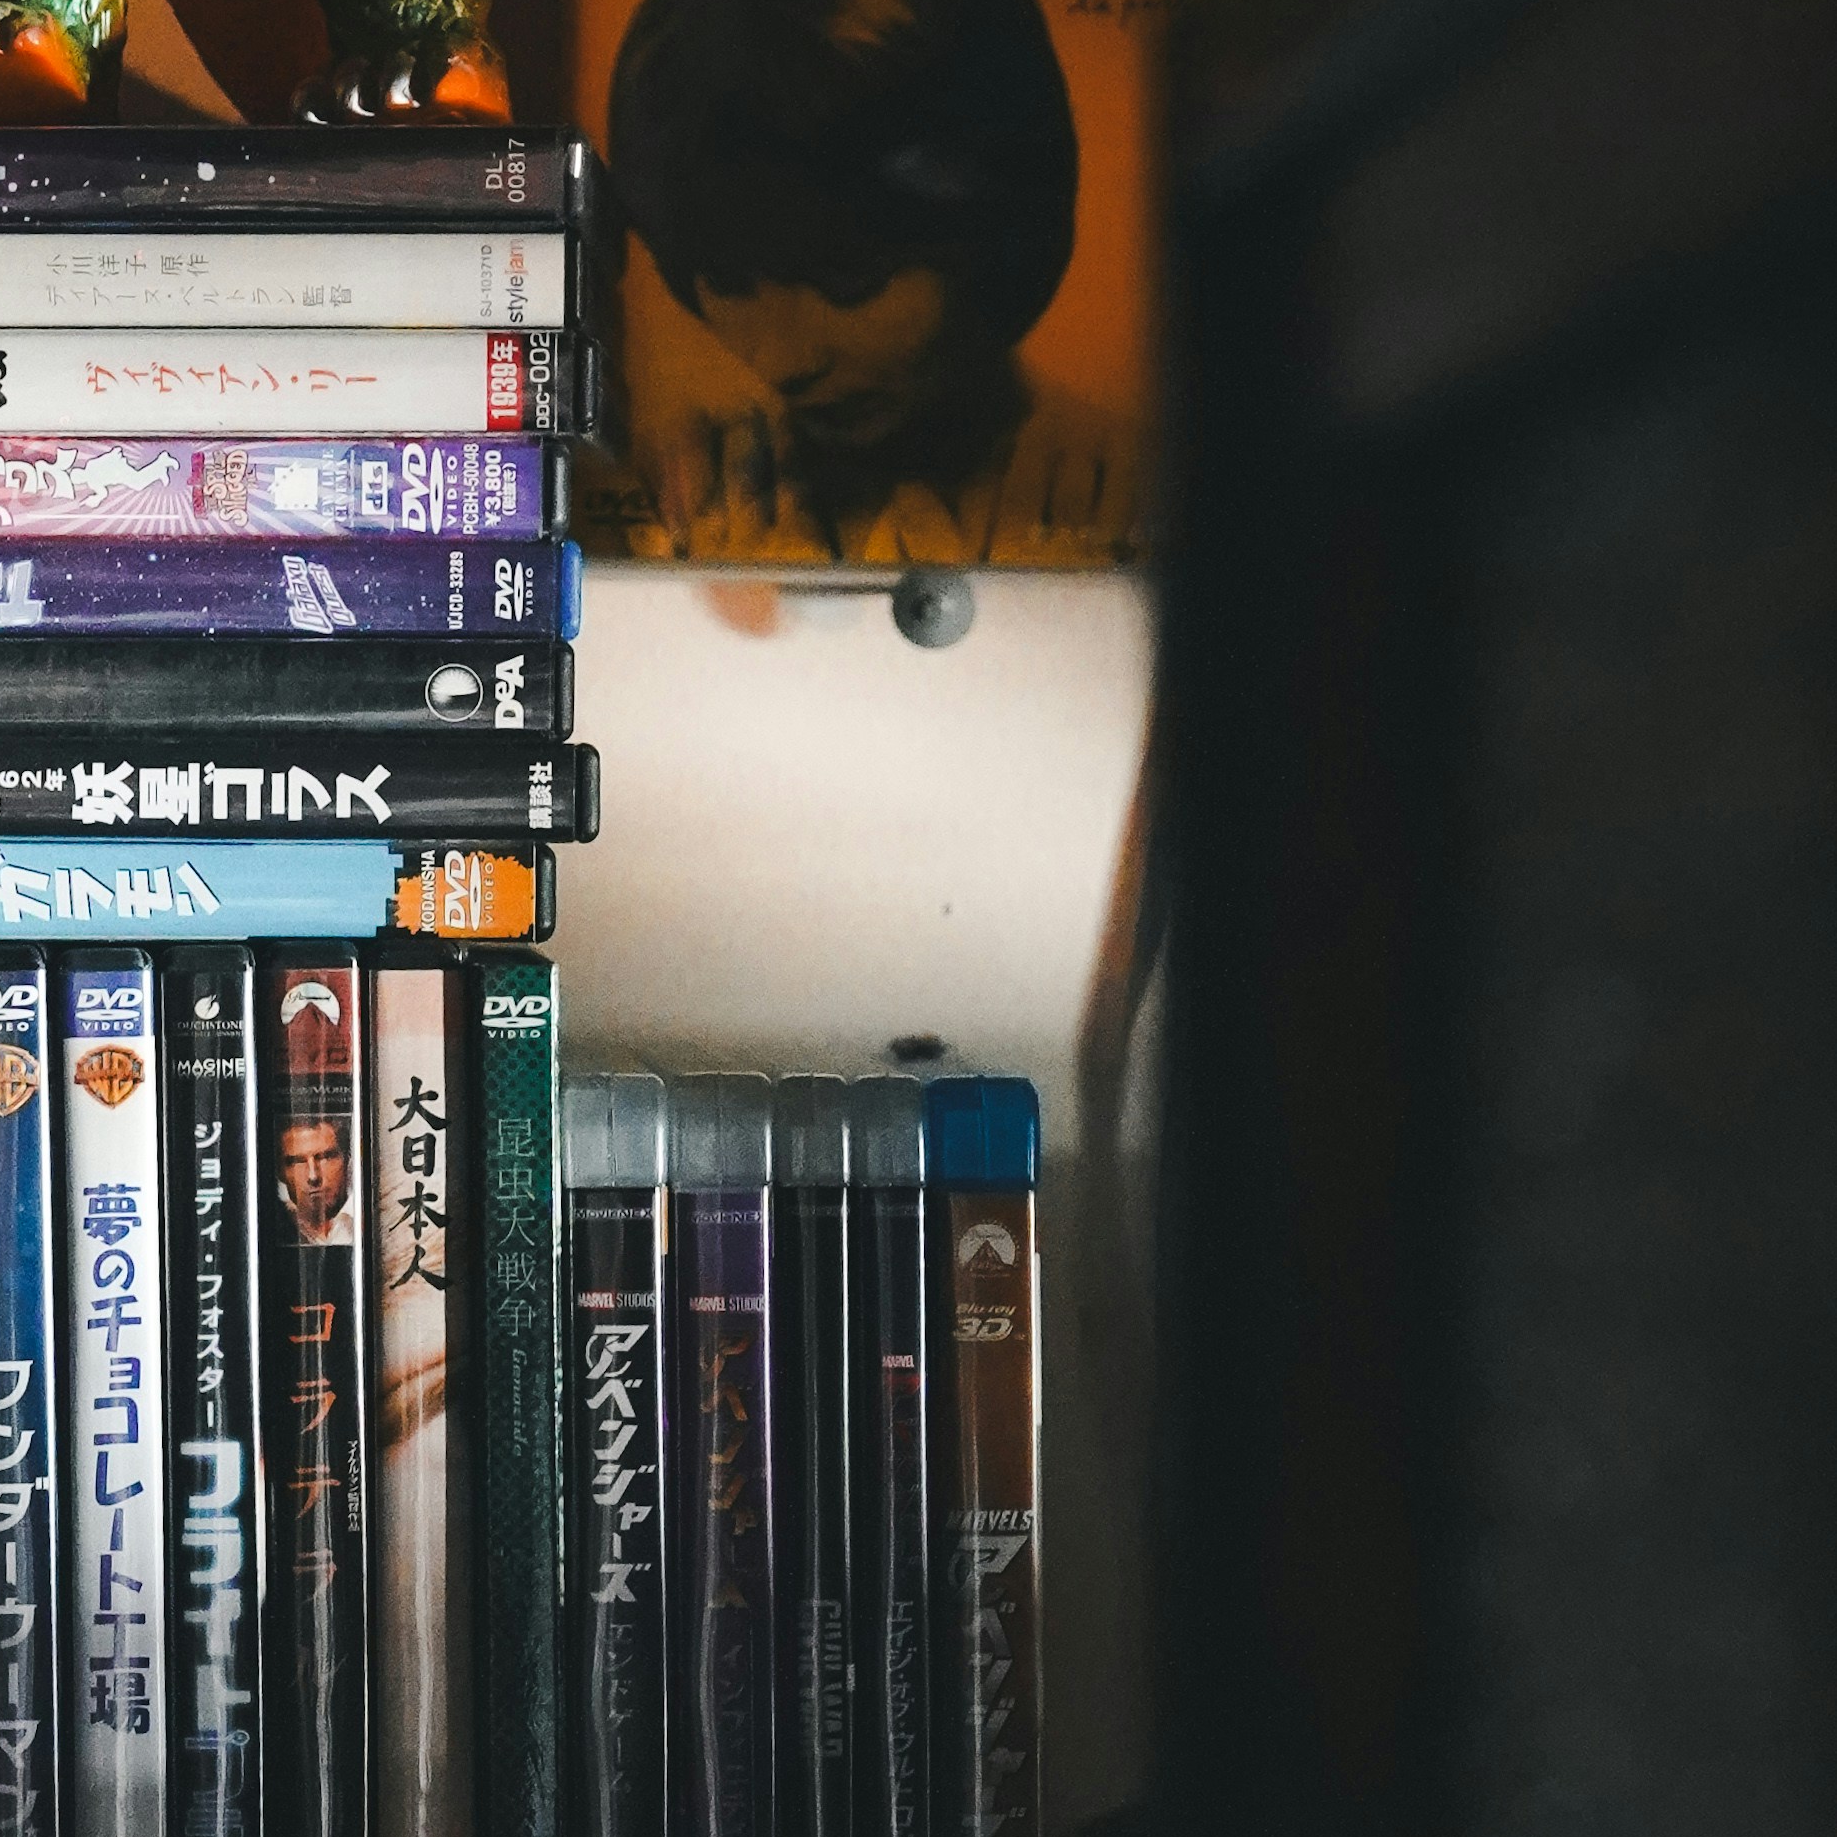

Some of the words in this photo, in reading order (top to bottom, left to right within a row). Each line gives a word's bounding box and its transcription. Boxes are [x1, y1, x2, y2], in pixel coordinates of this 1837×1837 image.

[507, 137, 526, 204] 00817
[508, 238, 526, 324] stylejam
[84, 361, 379, 396] ヴィヴィアン・リー
[490, 338, 520, 421] 1939年
[364, 466, 385, 511] dts
[399, 442, 427, 535] DVD
[484, 449, 502, 526] ¥3,800
[448, 550, 463, 631] UJCD-33289
[494, 558, 513, 621] DVD
[71, 761, 392, 826] 妖星ゴラス
[529, 760, 553, 830] 講談社
[421, 849, 435, 933] KODANSHA
[444, 850, 466, 931] DVD
[387, 1075, 452, 1292] 大日本人
[496, 1116, 537, 1338] 昆虫大戦争
[192, 1120, 225, 1429] ジョディ・フォスター
[577, 1292, 615, 1310] MARVEL
[616, 1292, 657, 1309] STUDIOS
[688, 1296, 726, 1312] MARVEL
[82, 1183, 151, 1736] 夢のチョコレート工場
[287, 1303, 343, 1675] コラテラ
[585, 1323, 658, 1604] アベンジャーズ
